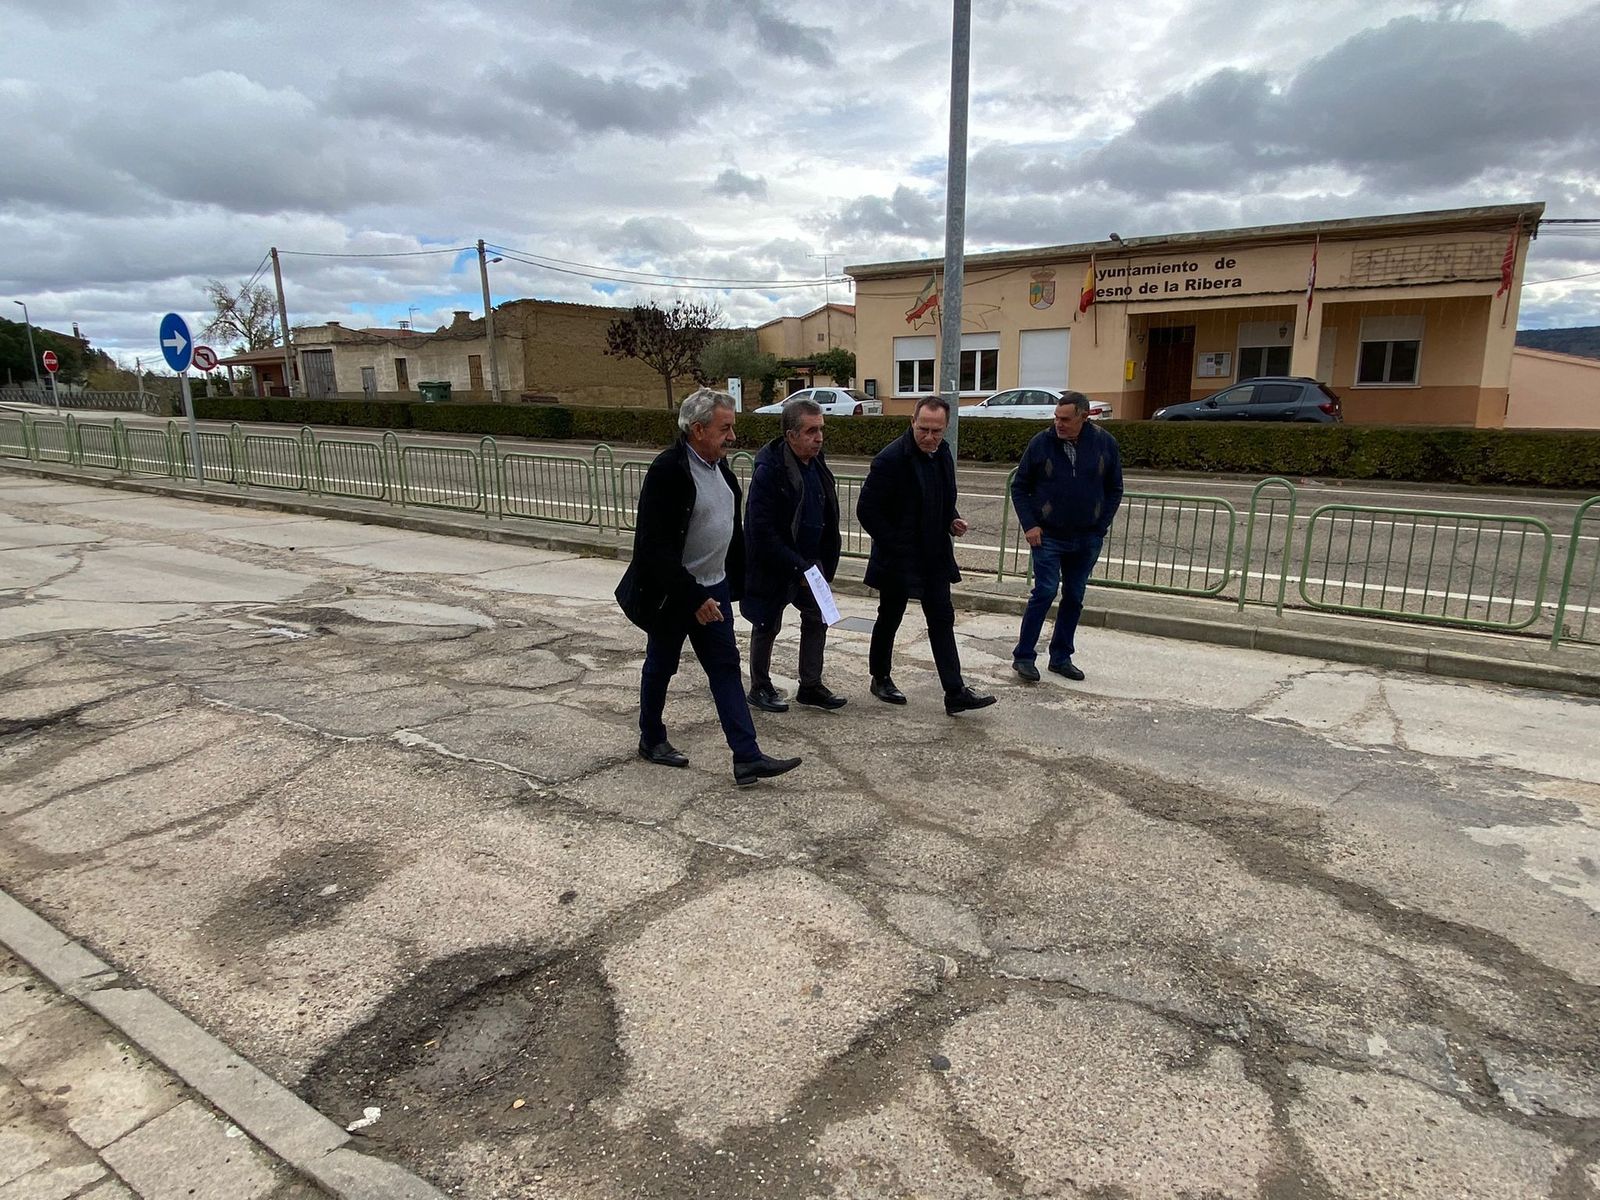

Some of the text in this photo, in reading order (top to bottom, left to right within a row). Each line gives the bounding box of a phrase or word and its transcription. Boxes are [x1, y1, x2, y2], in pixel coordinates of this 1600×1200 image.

[1214, 257, 1236, 270] de
[1081, 278, 1242, 297] esno de la Ribera
